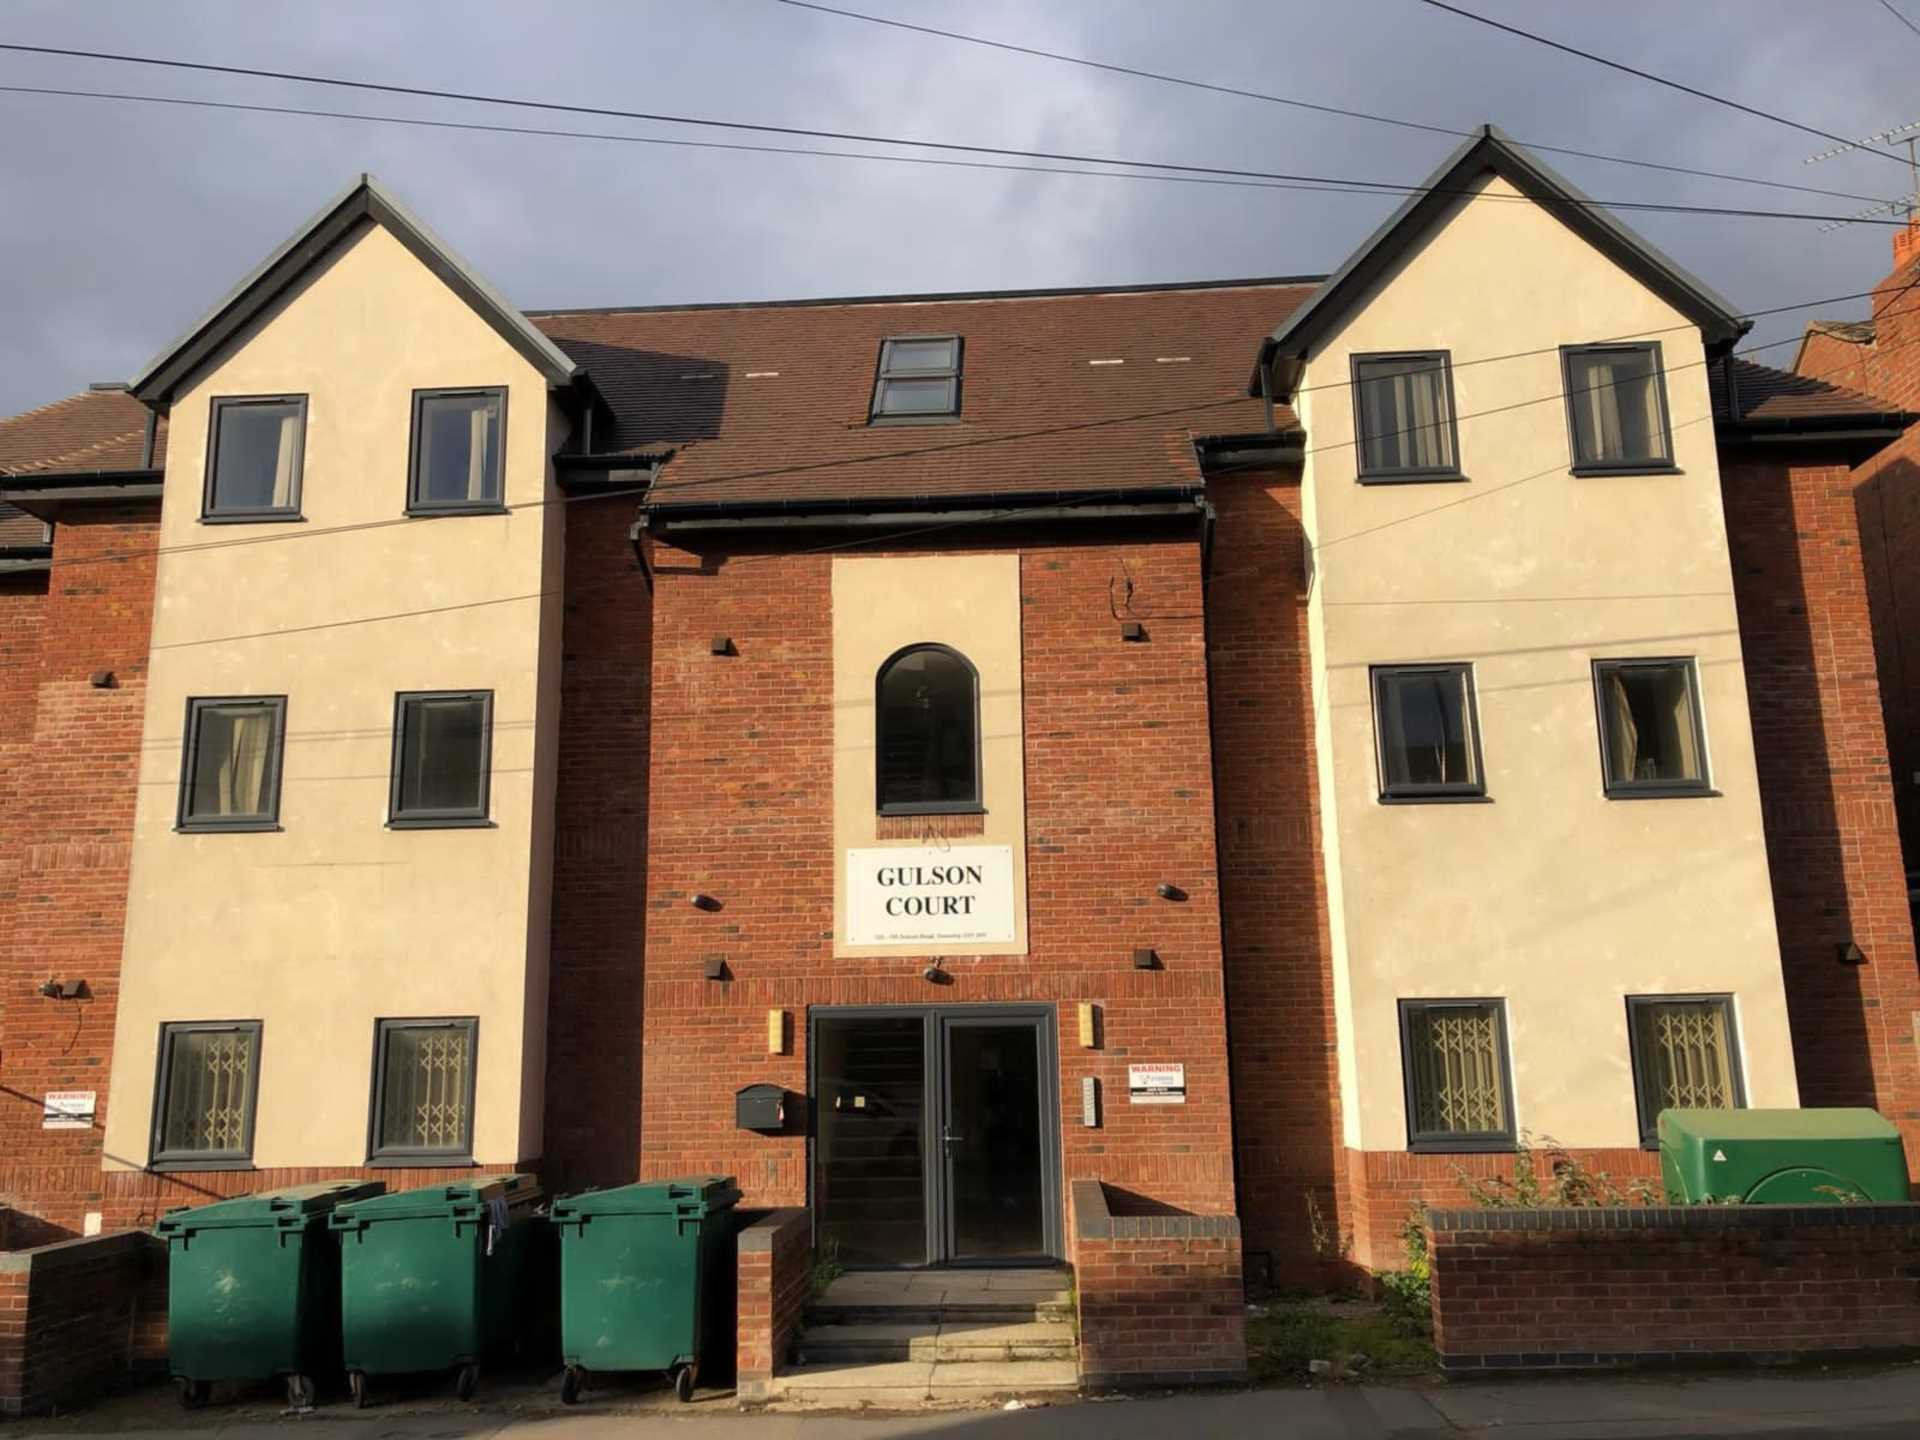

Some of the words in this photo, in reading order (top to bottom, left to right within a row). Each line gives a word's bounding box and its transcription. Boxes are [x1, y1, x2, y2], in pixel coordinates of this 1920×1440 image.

[877, 865, 983, 887] GULSON
[885, 895, 976, 917] COURT
[1131, 1065, 1181, 1073] WARNING
